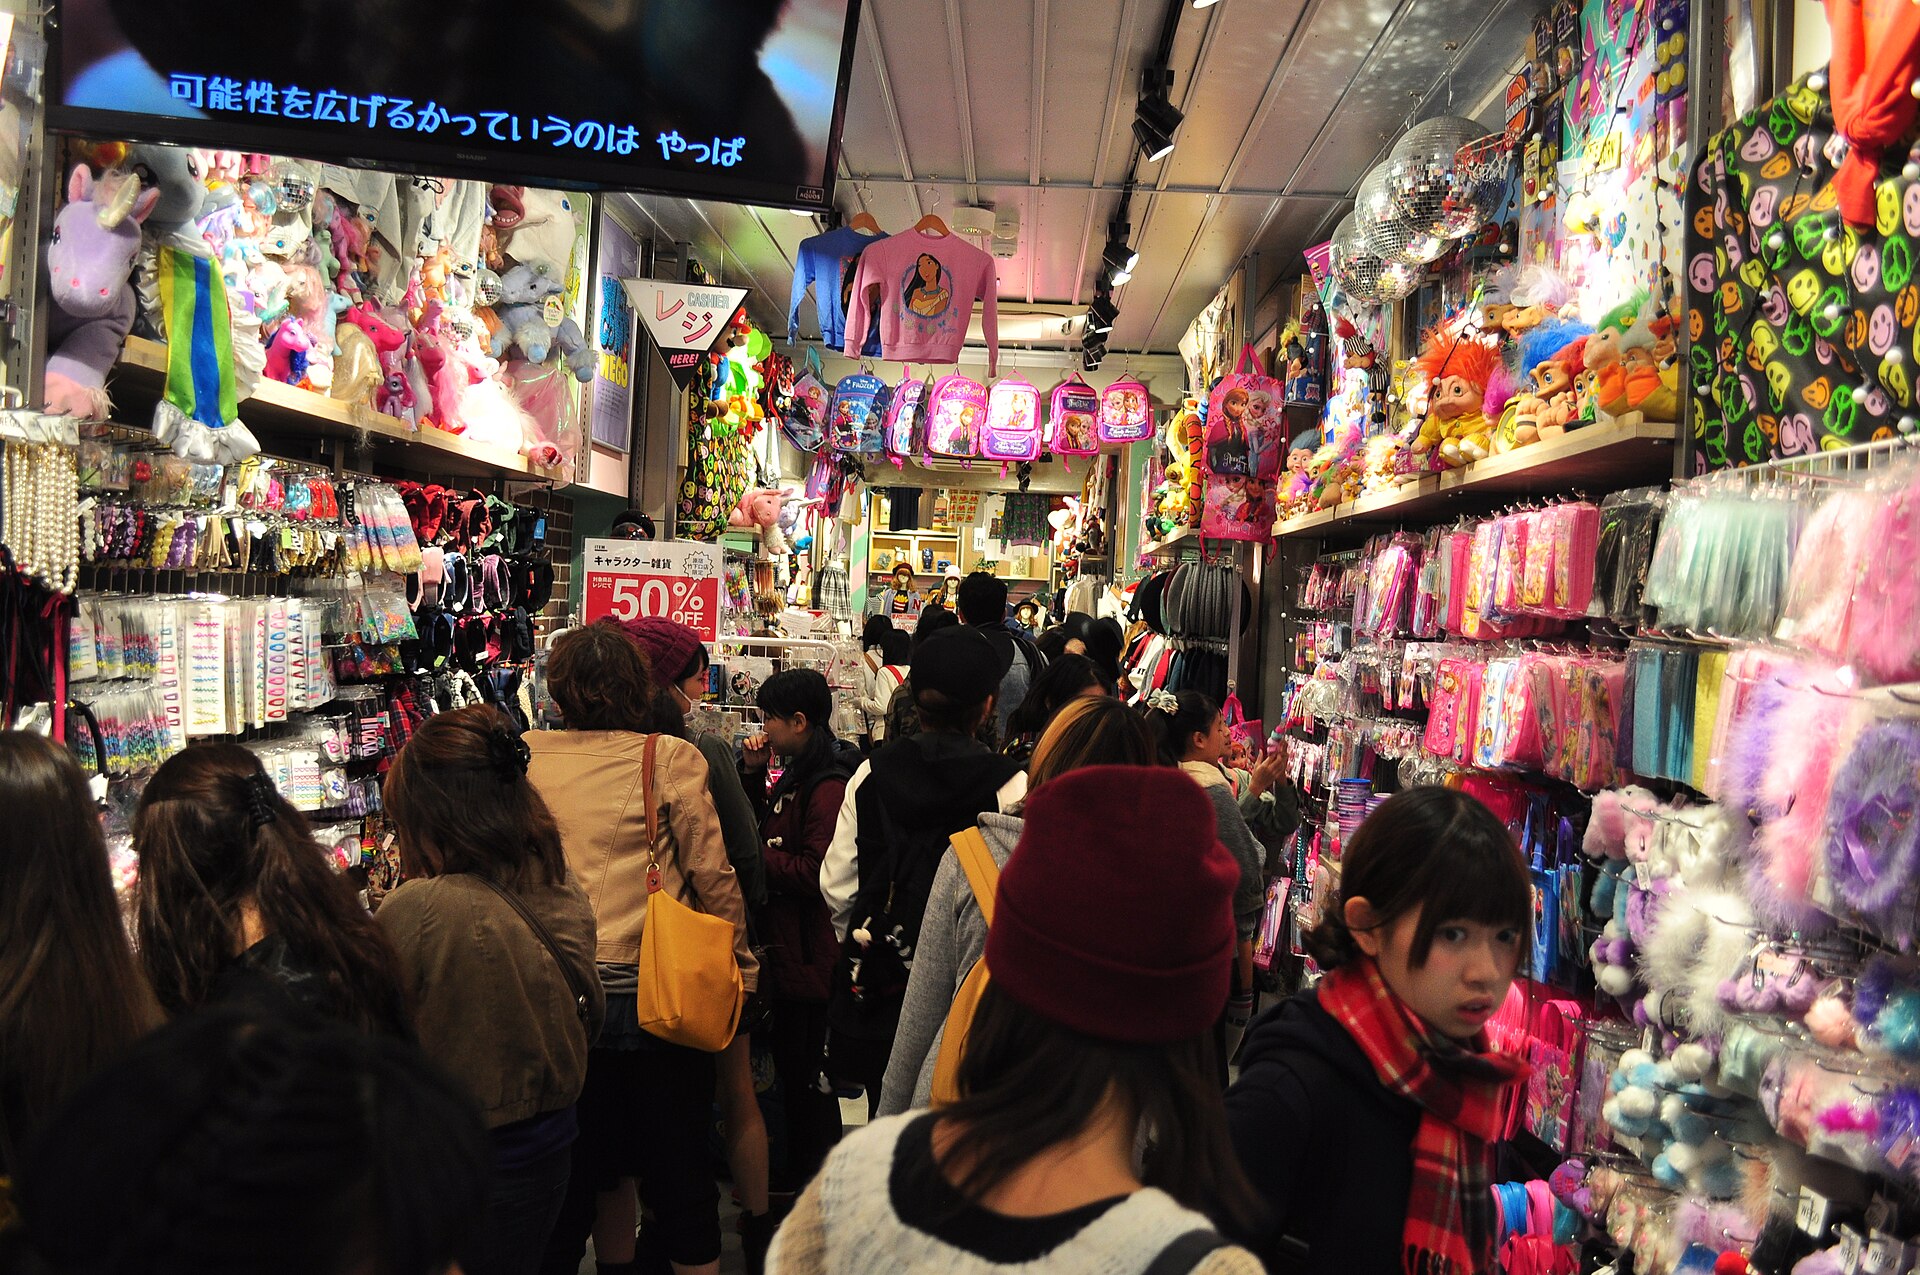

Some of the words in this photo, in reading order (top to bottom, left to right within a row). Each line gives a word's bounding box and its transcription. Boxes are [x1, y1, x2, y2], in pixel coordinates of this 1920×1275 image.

[171, 74, 639, 154] 可能性を広げるかっていうのは
[656, 131, 746, 167] やっぱ
[799, 192, 820, 200] AQUOS
[687, 292, 730, 309] CASHIER
[656, 290, 713, 344] レジ
[669, 353, 699, 365] HERE!
[600, 353, 629, 389] WEGO
[852, 381, 875, 390] FROZEN
[594, 555, 672, 570] キャラクター雑貨
[611, 578, 704, 621] 50%
[671, 610, 704, 626] OFF
